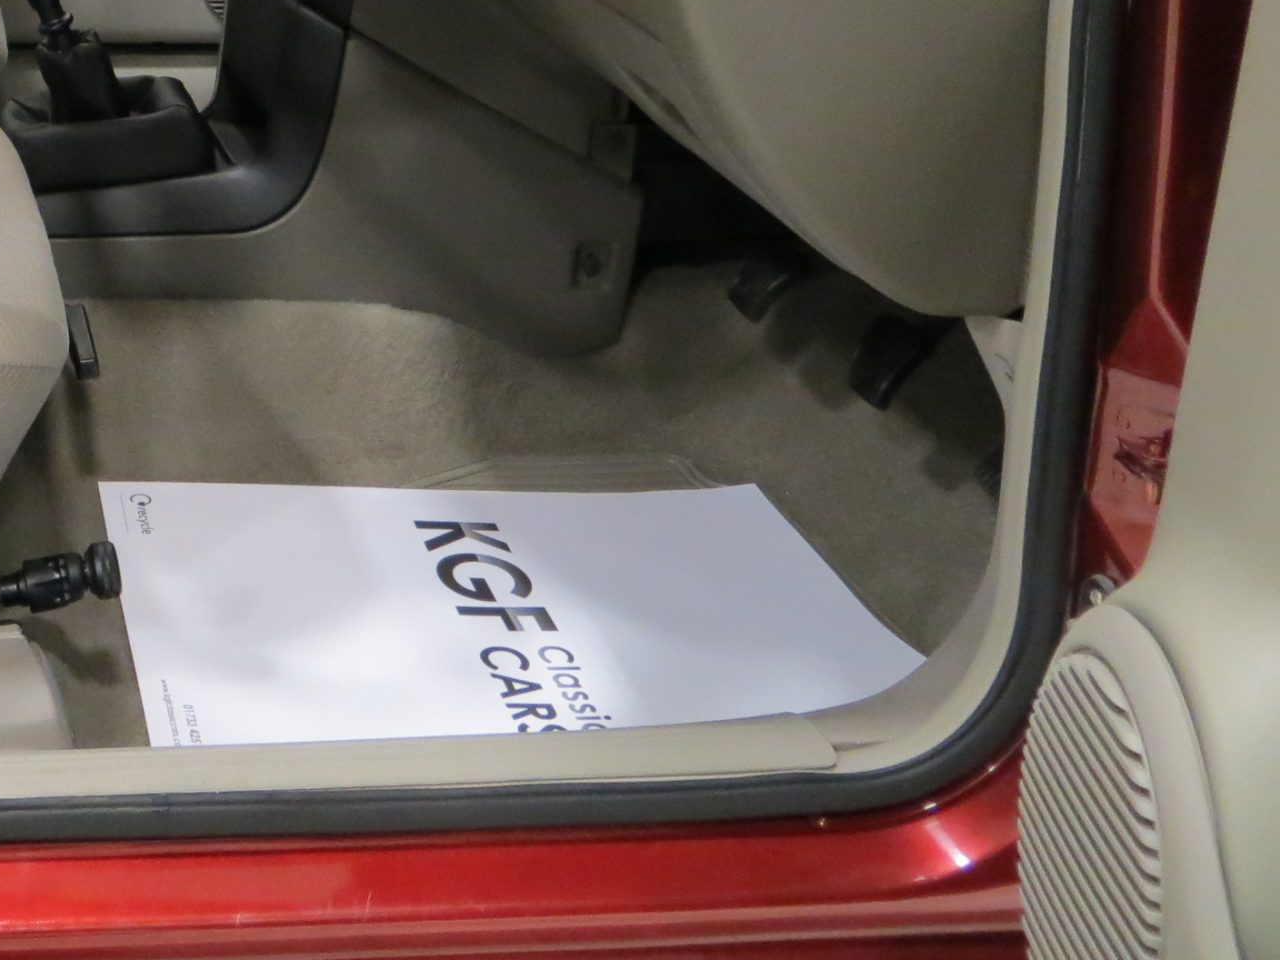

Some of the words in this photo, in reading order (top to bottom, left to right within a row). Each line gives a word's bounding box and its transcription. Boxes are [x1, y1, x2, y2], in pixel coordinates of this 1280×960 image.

[136, 507, 154, 535] recycle
[413, 520, 559, 632] KGF
[182, 704, 198, 727] 01733
